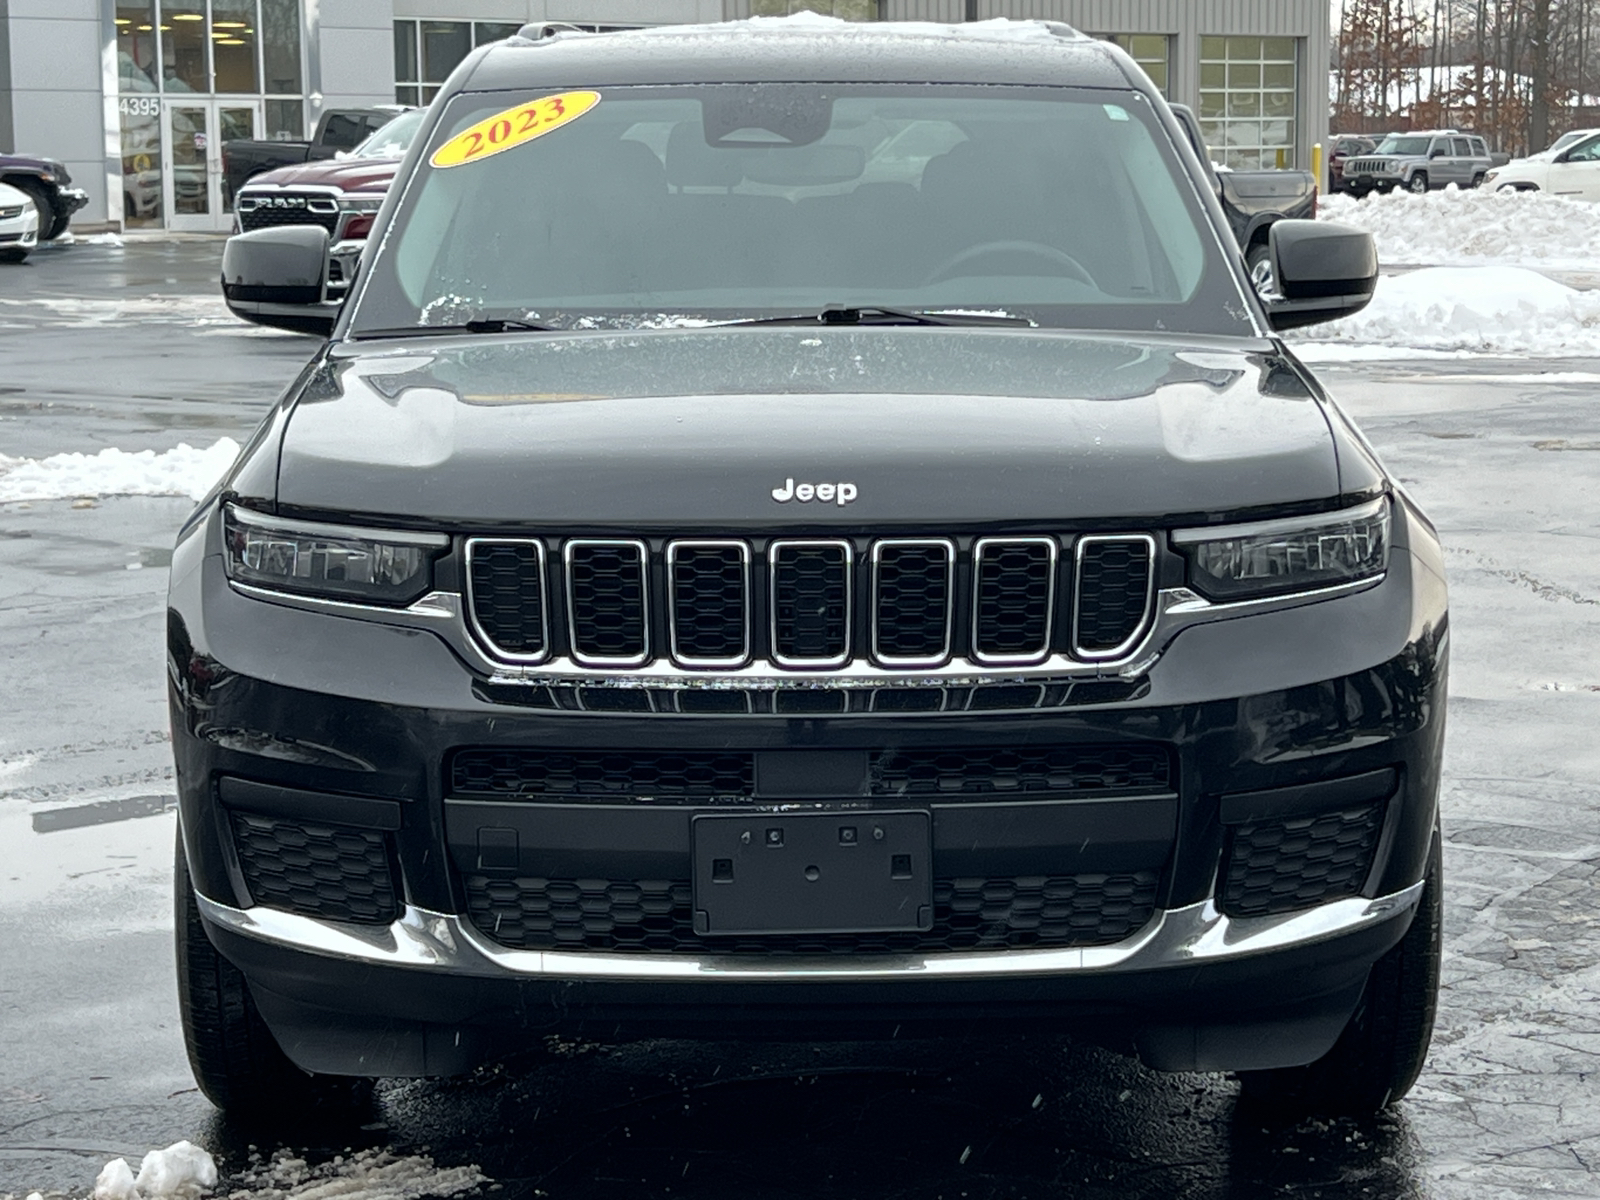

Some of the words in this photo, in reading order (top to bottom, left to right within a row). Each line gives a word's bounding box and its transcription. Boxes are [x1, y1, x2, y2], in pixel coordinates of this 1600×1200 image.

[119, 98, 160, 116] 4395
[462, 98, 565, 158] 2023
[256, 197, 306, 209] RAM
[771, 478, 858, 505] Jeep
